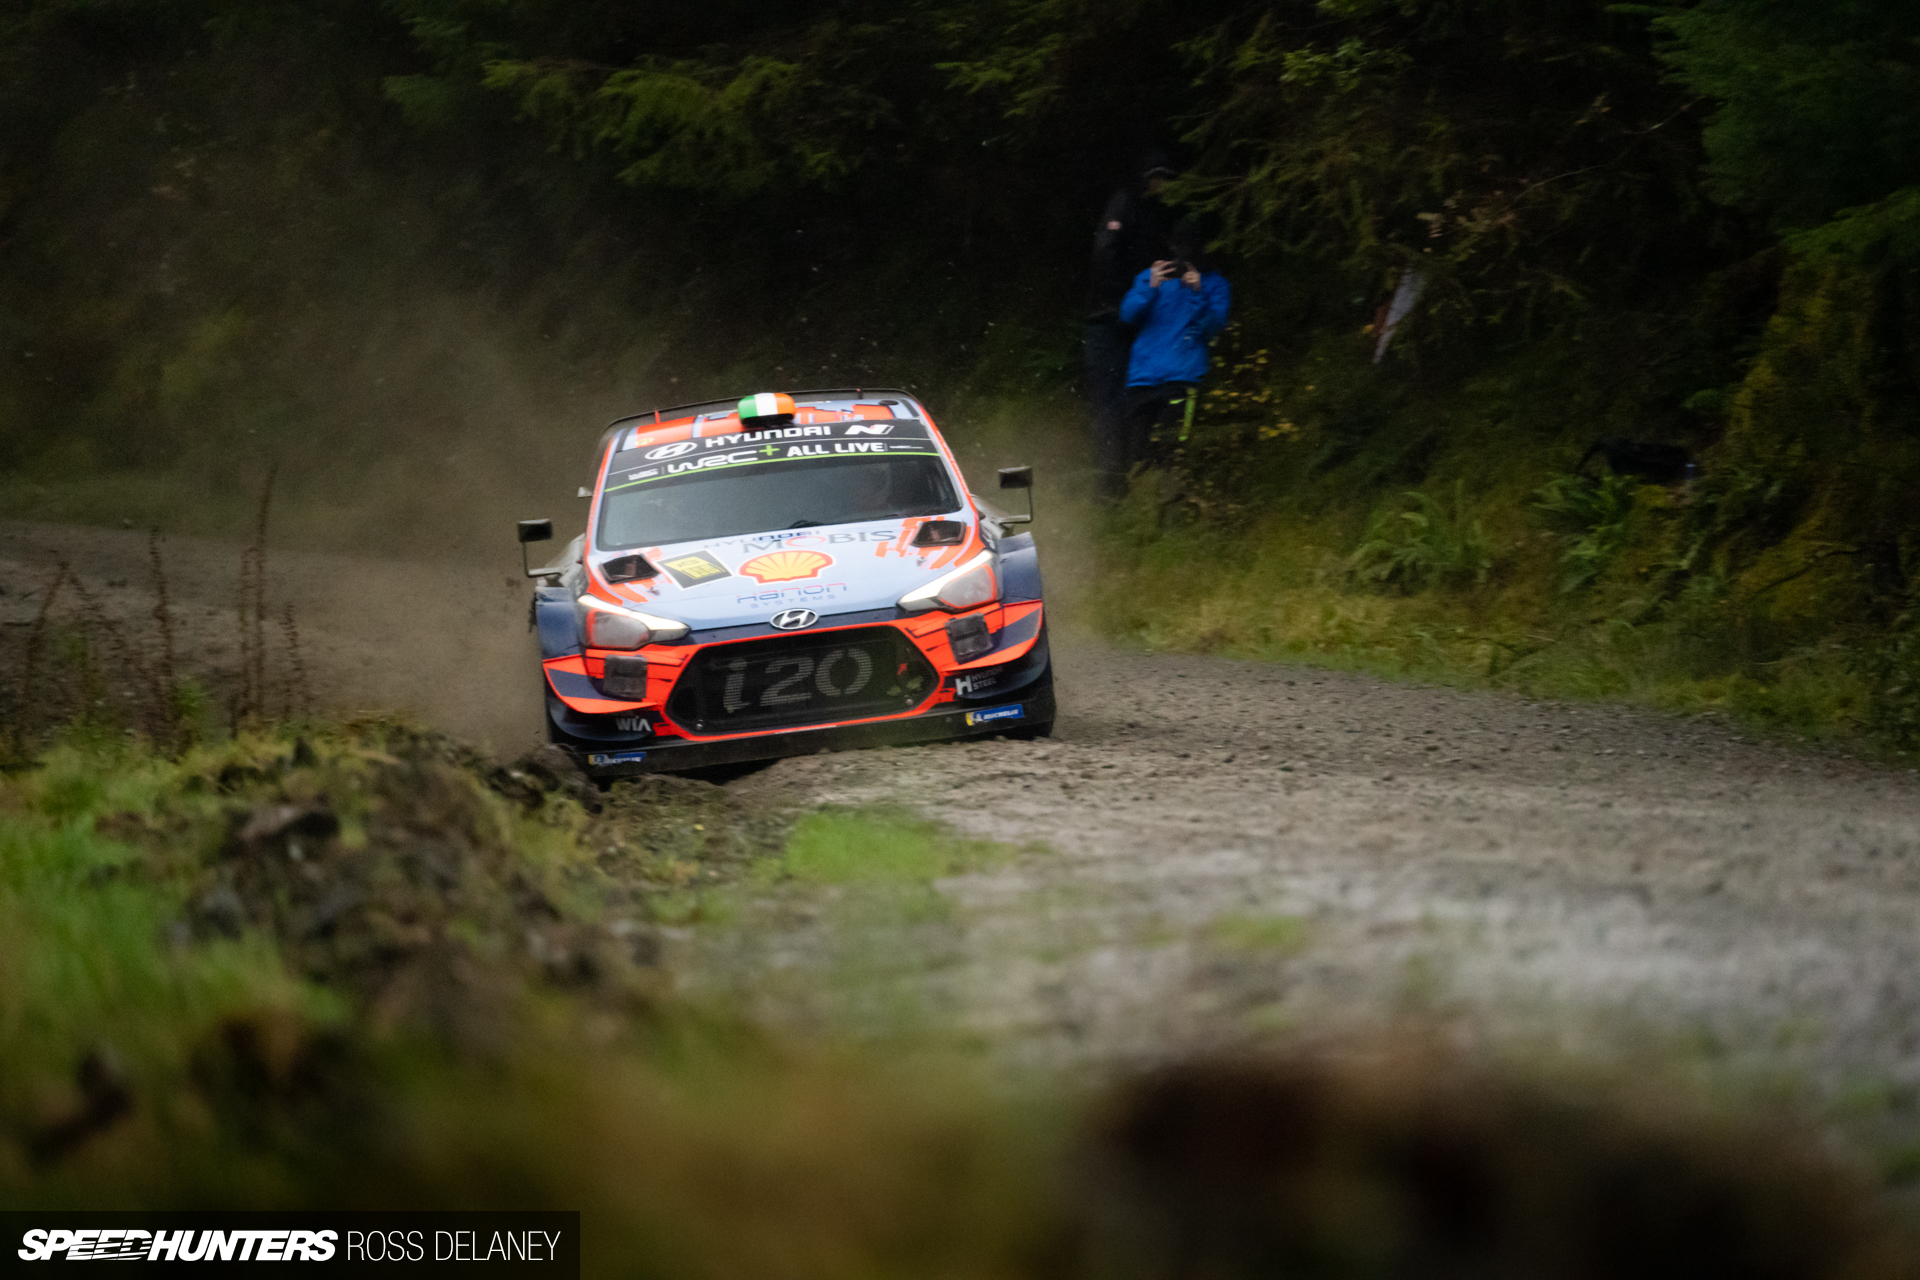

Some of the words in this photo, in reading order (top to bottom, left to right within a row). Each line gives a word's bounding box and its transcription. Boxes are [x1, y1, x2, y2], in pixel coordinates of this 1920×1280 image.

[705, 425, 831, 448] HYUNDAI
[787, 444, 830, 457] ALL
[834, 442, 885, 453] LIVE
[742, 530, 897, 554] MOBIS
[750, 594, 836, 609] SYSTEMS
[723, 648, 873, 713] i20
